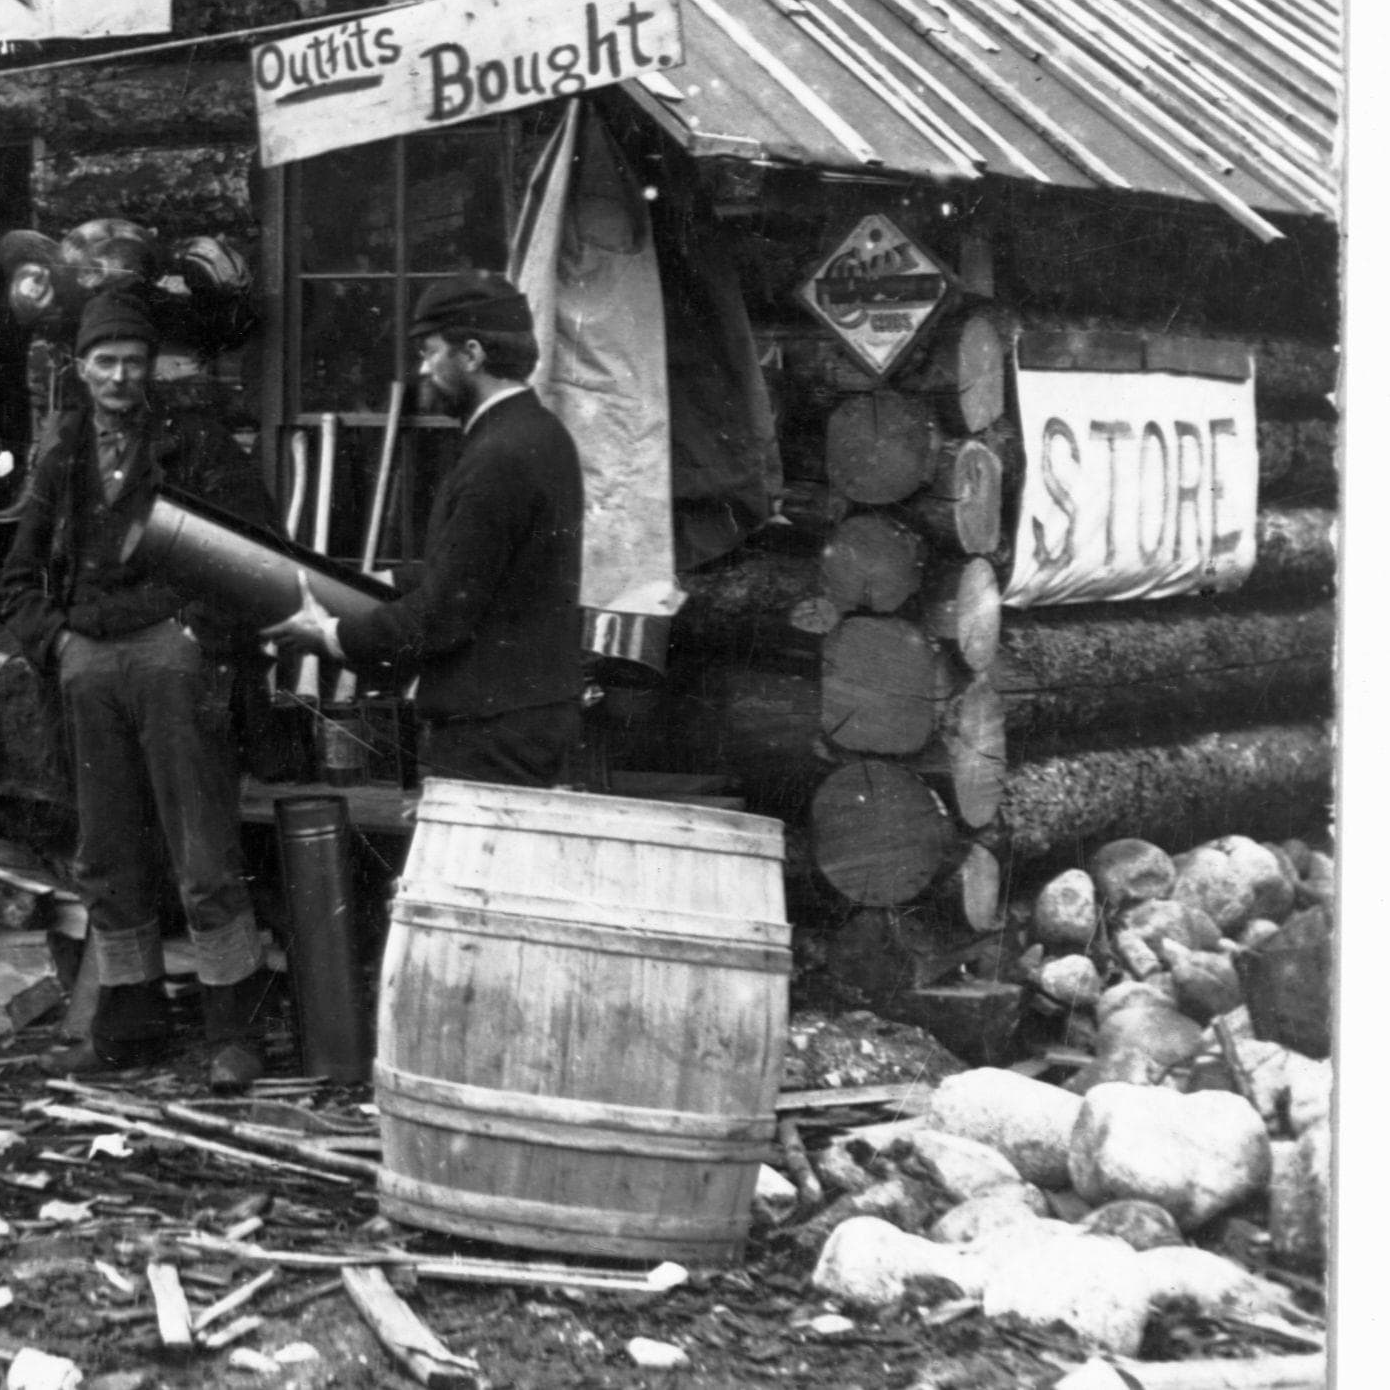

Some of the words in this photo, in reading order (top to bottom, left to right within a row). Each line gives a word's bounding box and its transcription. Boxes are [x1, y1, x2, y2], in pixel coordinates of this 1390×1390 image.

[255, 21, 402, 91] Outfits
[419, 0, 673, 122] Bought.
[1031, 416, 1243, 568] STORE
